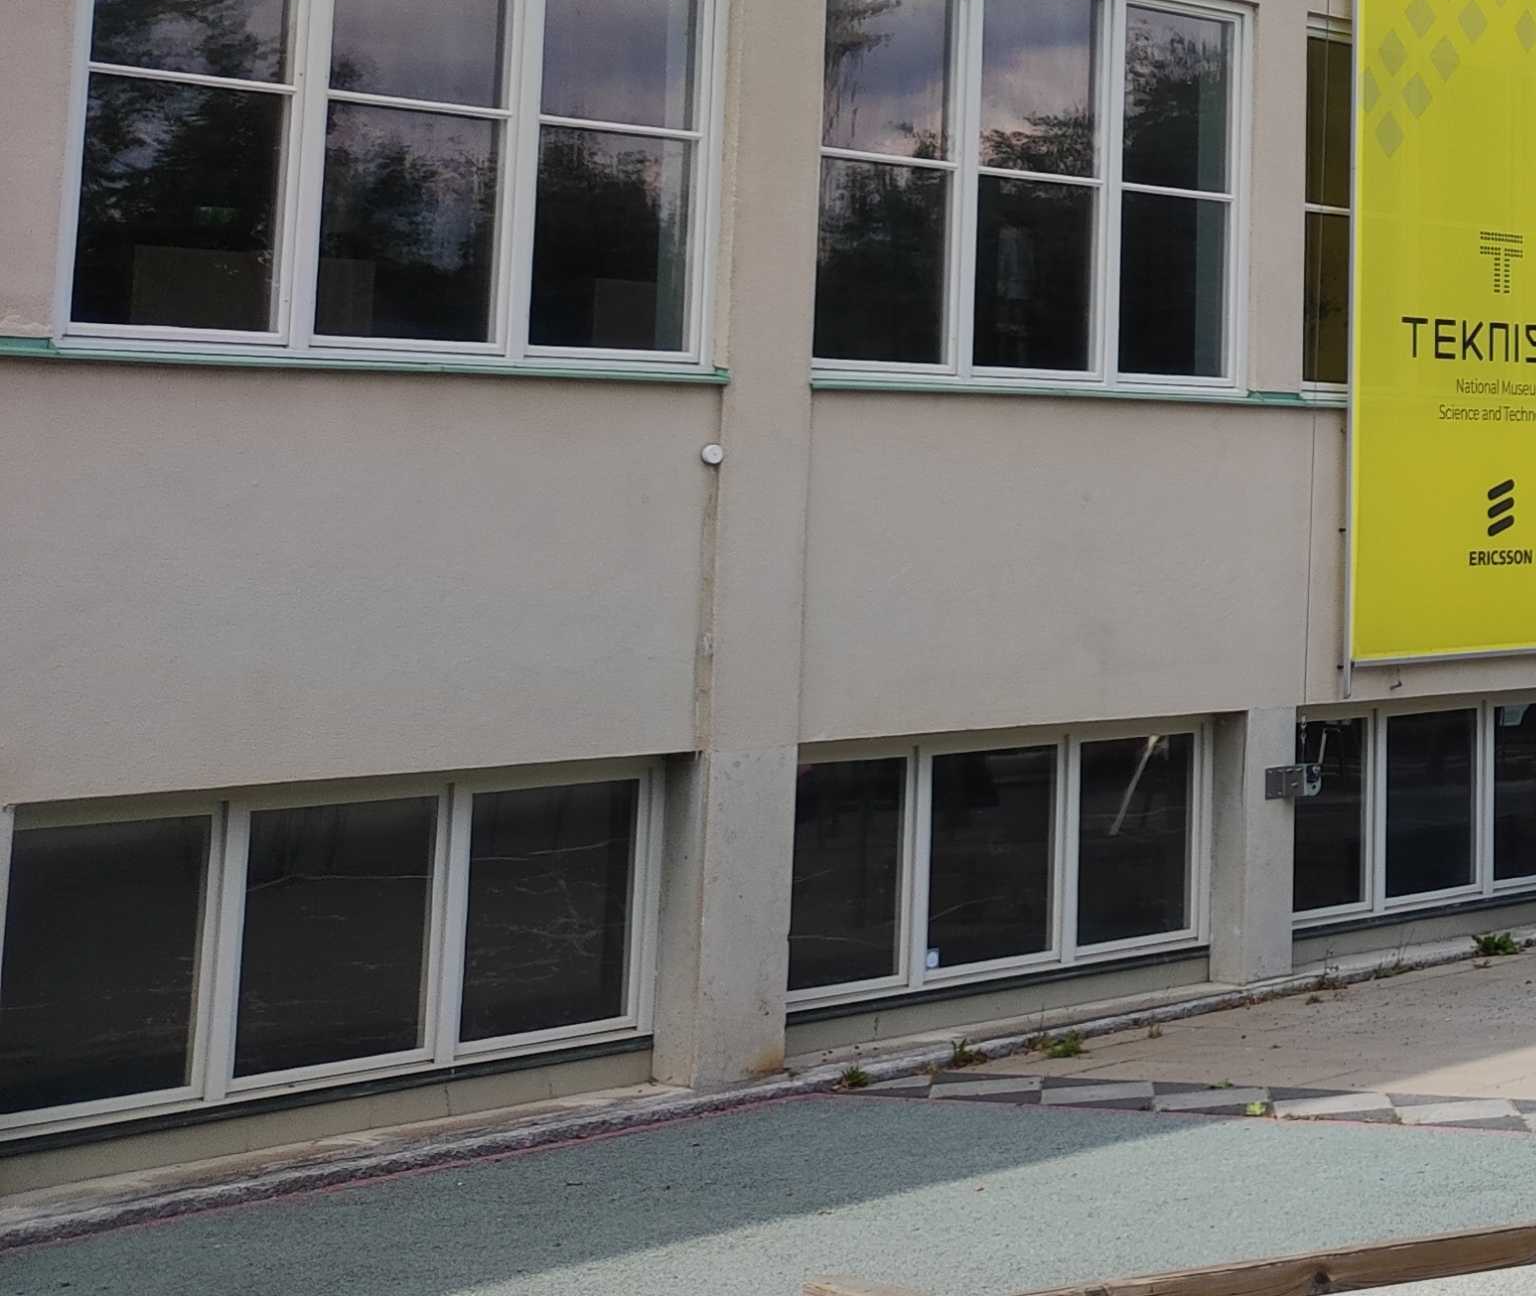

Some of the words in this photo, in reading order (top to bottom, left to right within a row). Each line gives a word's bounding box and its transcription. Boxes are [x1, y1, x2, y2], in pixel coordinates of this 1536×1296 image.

[1456, 378, 1500, 394] National
[1439, 404, 1480, 421] Science
[1482, 405, 1502, 421] and
[1468, 549, 1533, 567] ERICSSON
